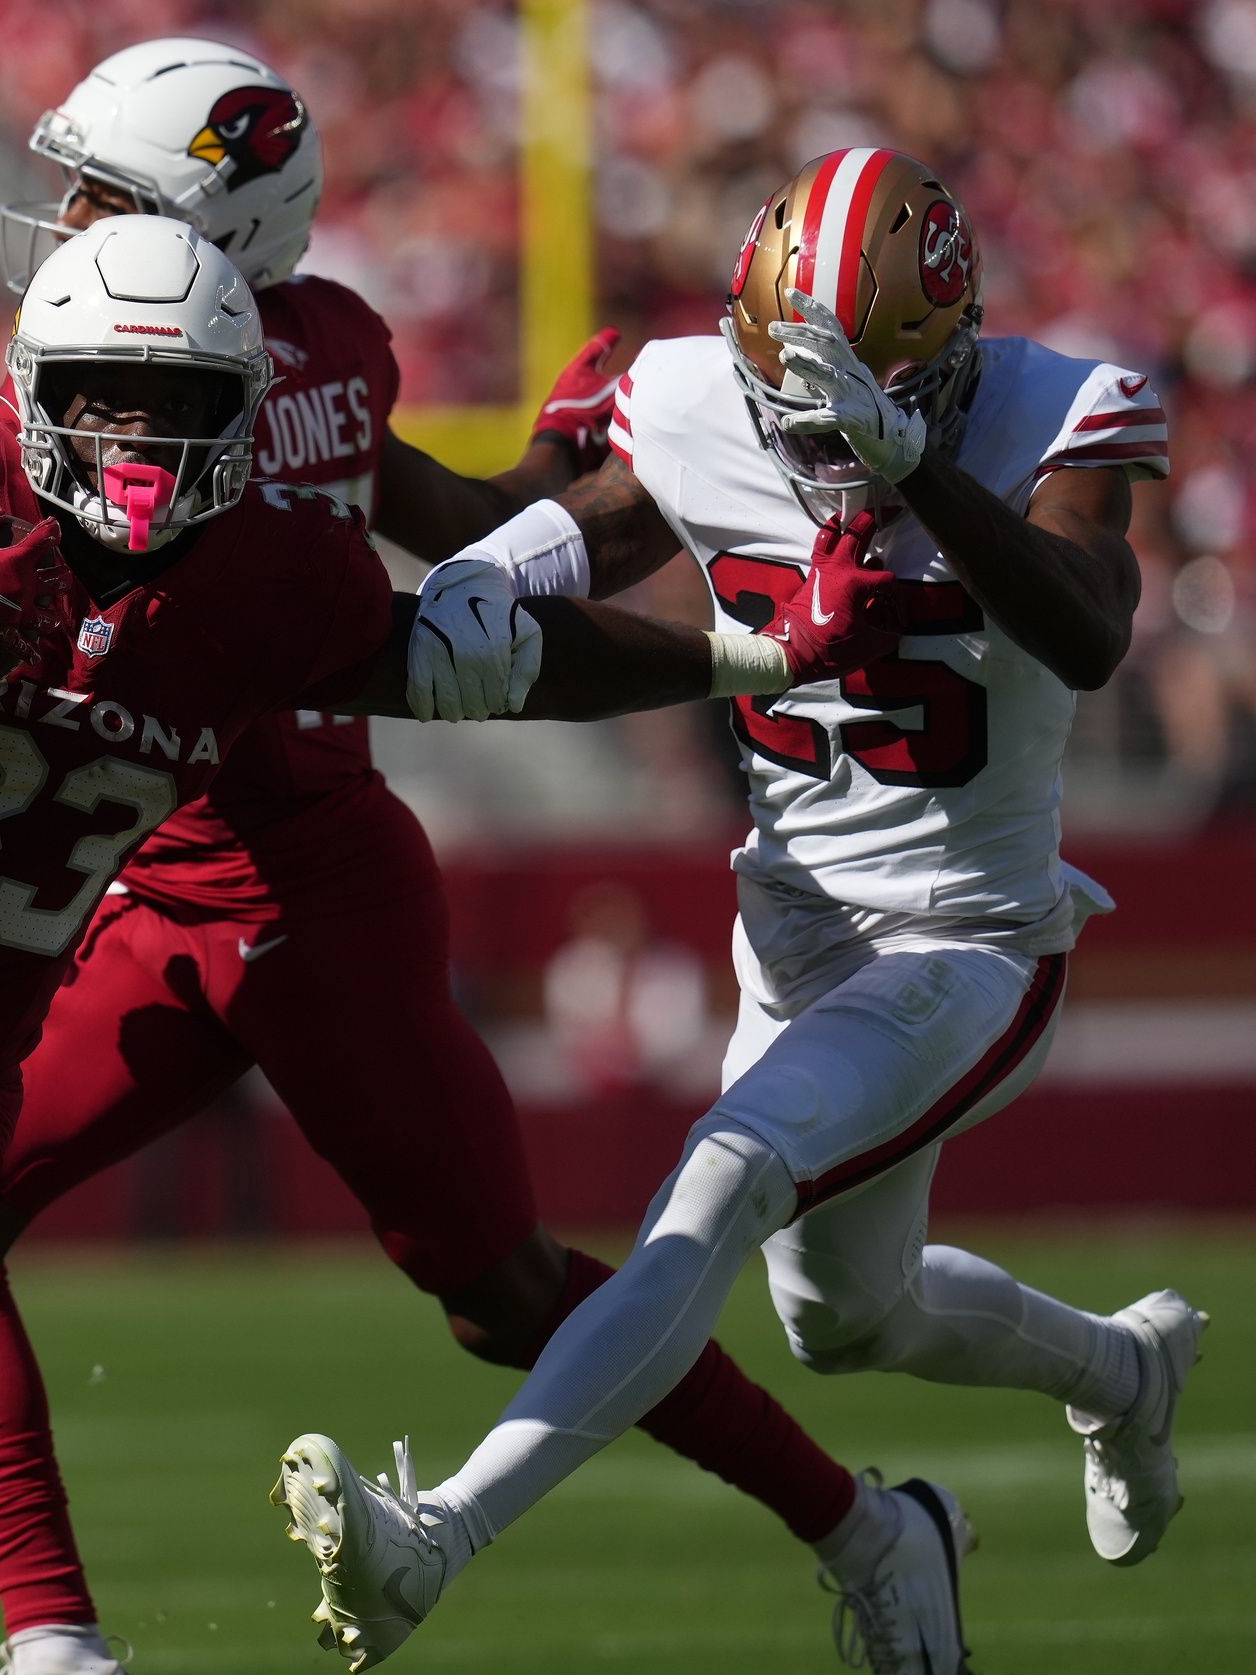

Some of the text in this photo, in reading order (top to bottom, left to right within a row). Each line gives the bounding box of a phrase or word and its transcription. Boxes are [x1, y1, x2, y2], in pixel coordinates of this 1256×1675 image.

[113, 324, 184, 337] CARDINALS
[257, 376, 372, 475] JONES
[82, 632, 105, 651] NFL
[706, 550, 988, 788] 25
